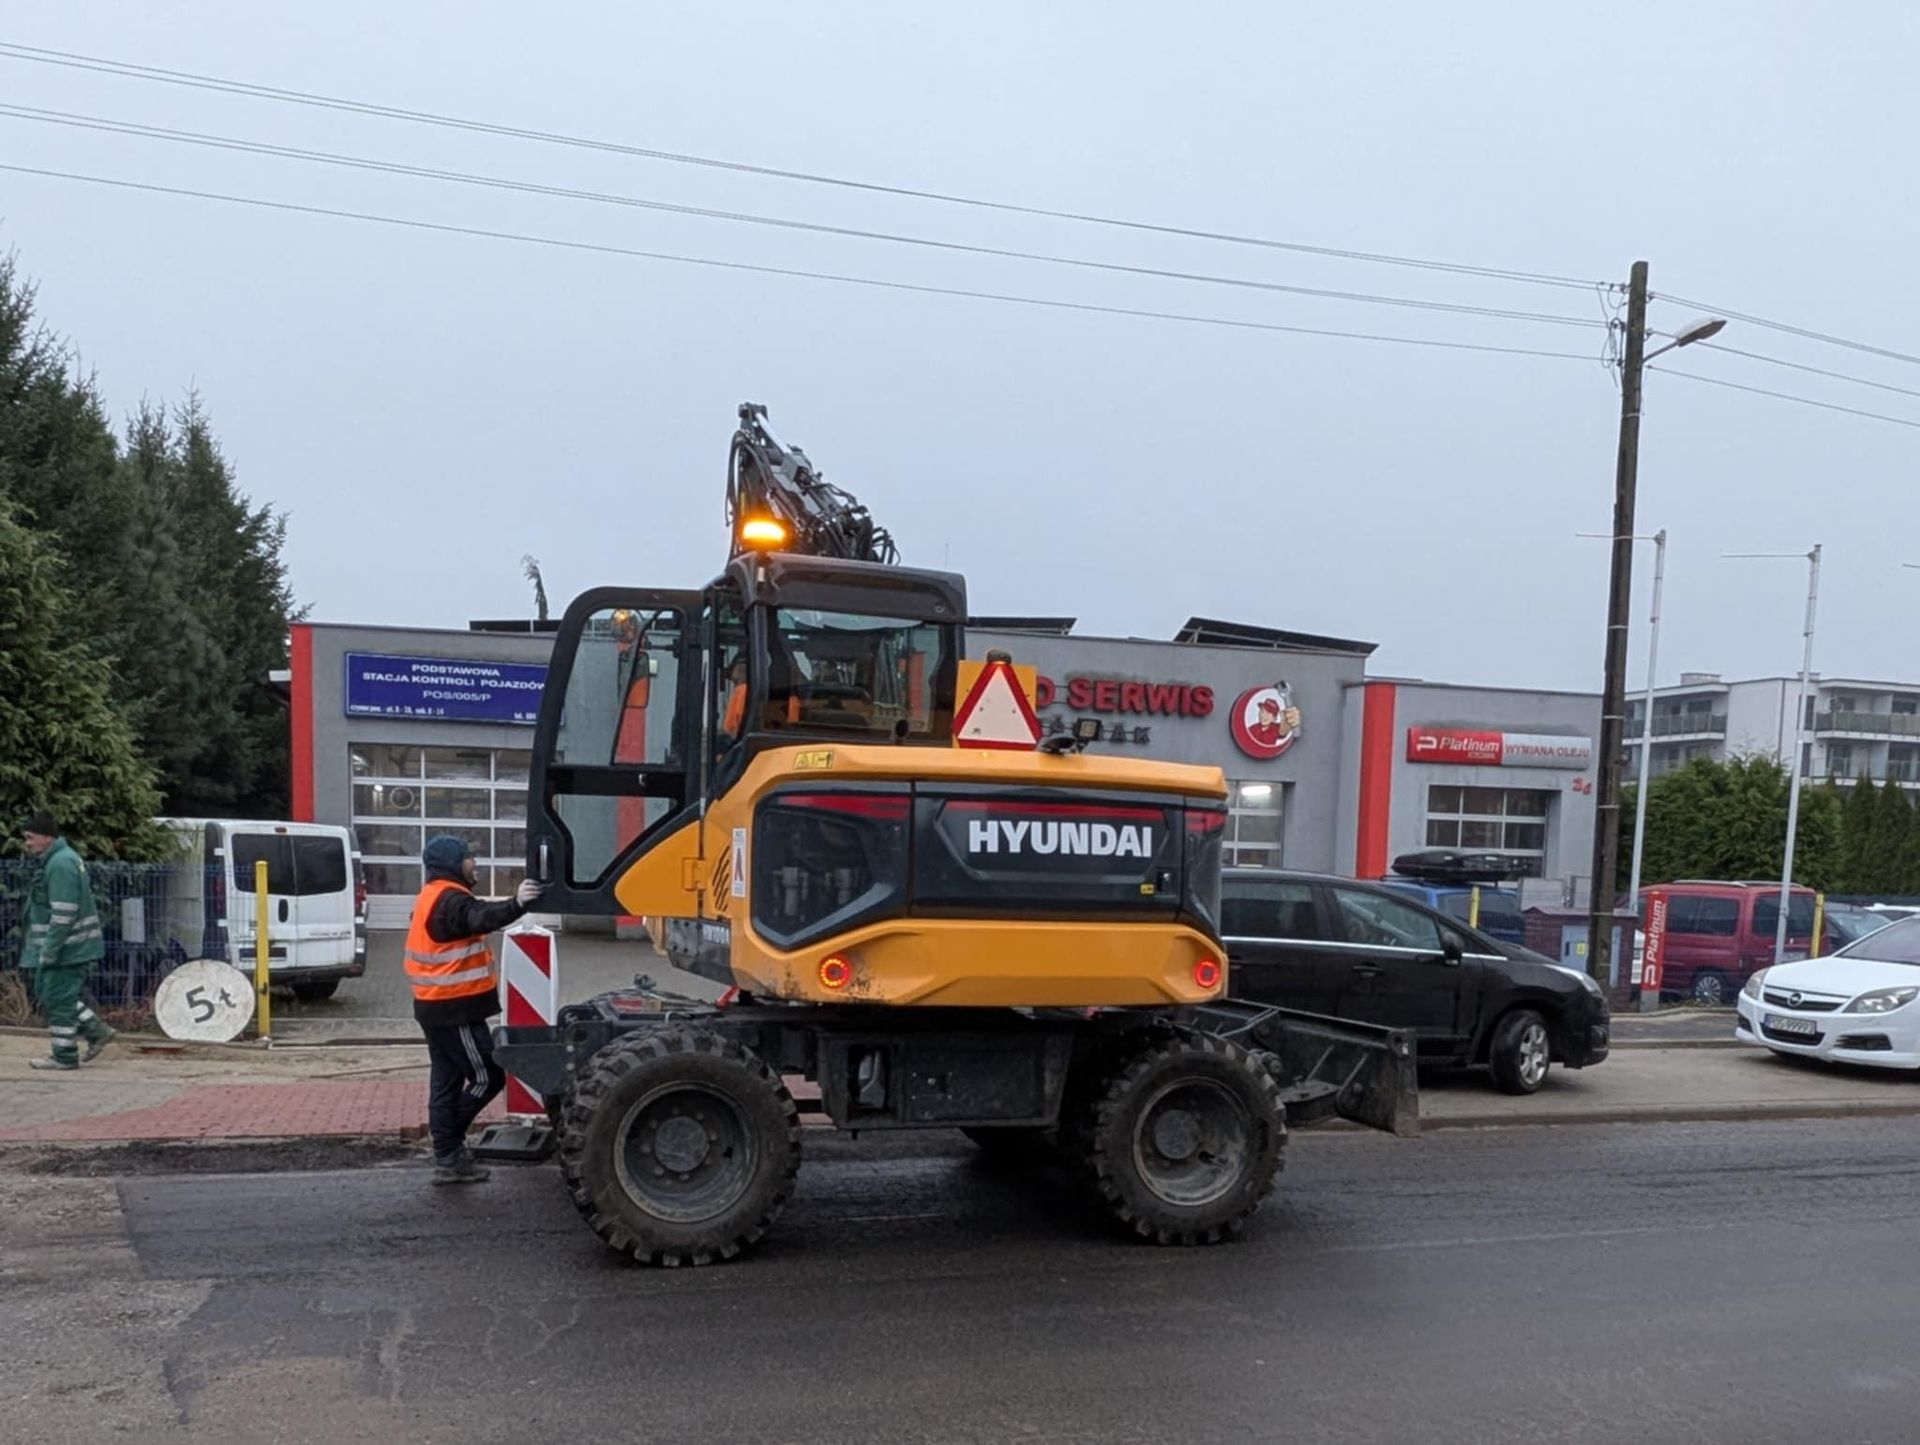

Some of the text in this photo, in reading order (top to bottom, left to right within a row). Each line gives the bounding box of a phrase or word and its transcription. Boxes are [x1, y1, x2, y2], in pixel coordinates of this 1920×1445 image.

[411, 664, 500, 676] PODSTAWOWA
[362, 672, 410, 683] STACJA
[411, 675, 475, 686] KONTROLI
[1067, 677, 1214, 717] SERWIS
[1439, 736, 1500, 752] Platinum
[1505, 743, 1554, 757] WYMIANA
[1557, 746, 1590, 758] OLEJU
[968, 820, 1152, 858] HYUNDAI
[1645, 899, 1662, 962] Platinum
